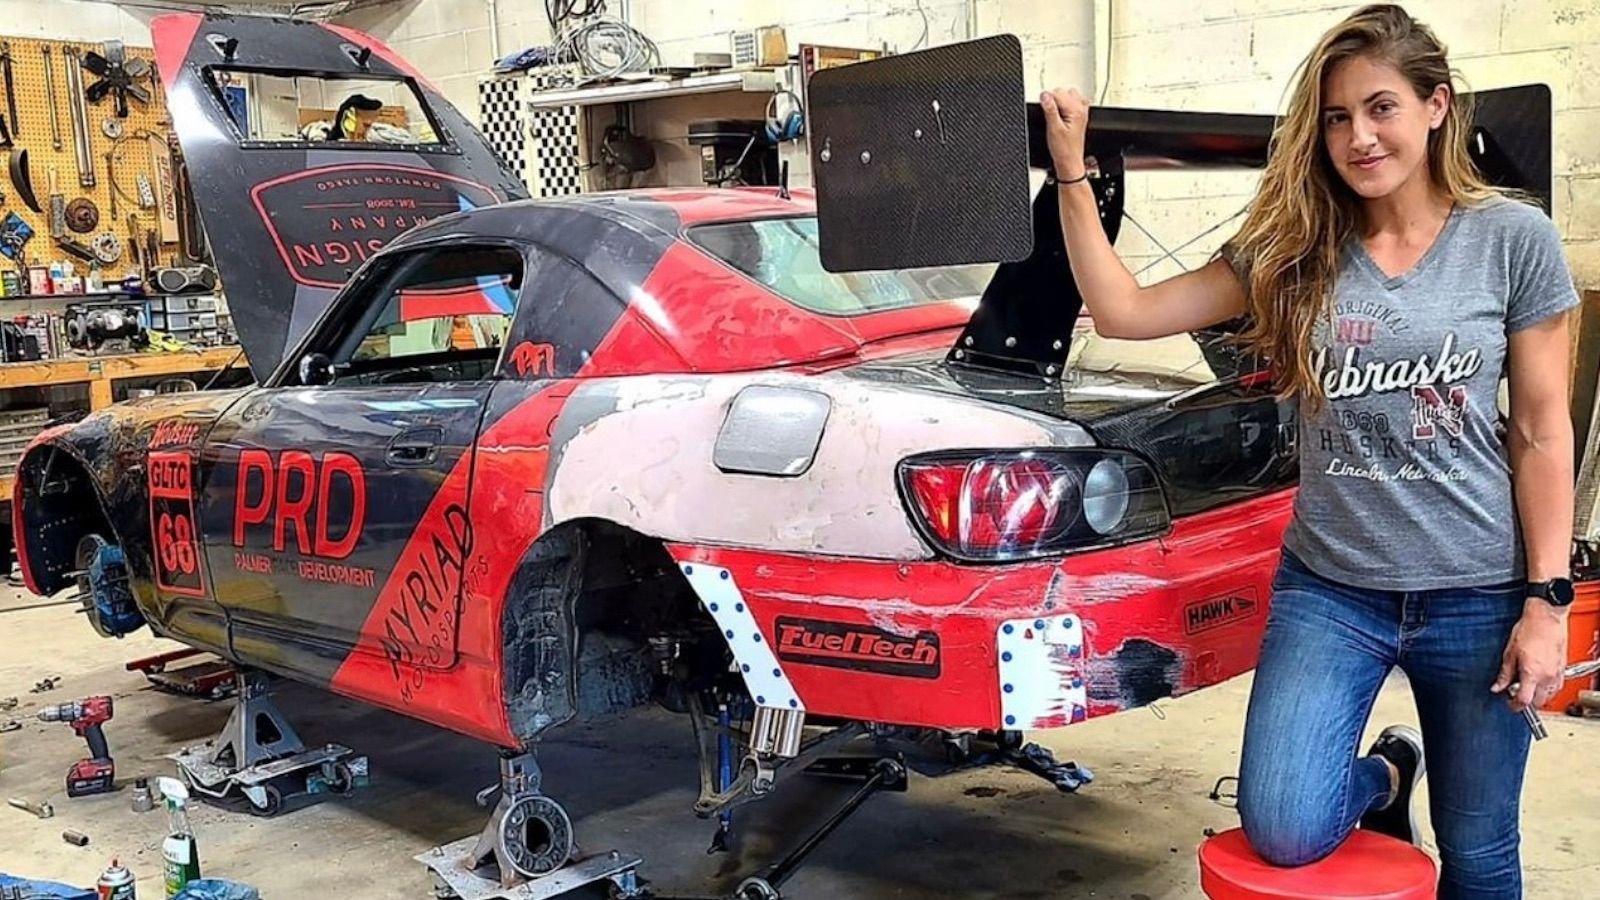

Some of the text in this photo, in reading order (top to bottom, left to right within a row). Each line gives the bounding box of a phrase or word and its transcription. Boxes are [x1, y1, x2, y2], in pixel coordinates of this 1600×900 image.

[330, 215, 428, 231] MPANY
[151, 461, 188, 490] GLTC
[233, 449, 366, 559] PRD
[158, 512, 195, 575] 68
[234, 552, 273, 575] PALMER
[298, 561, 375, 588] DEVELOPMENT
[379, 503, 474, 681] MYRIAD
[1188, 597, 1234, 626] HAWK
[779, 624, 938, 665] FuelTech
